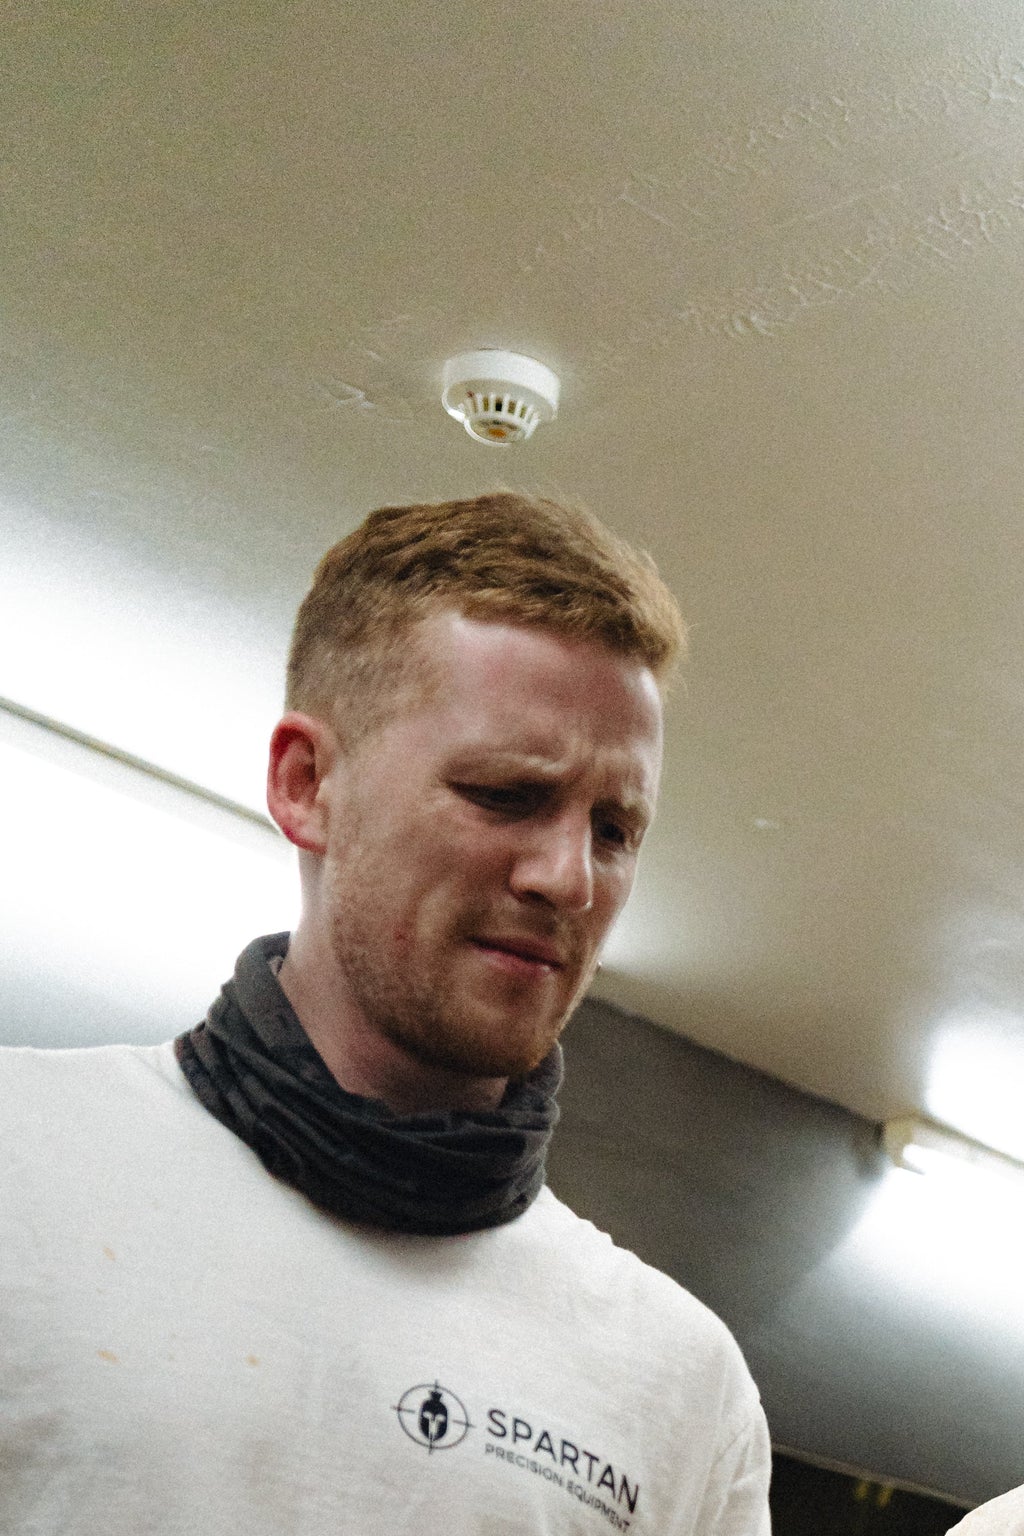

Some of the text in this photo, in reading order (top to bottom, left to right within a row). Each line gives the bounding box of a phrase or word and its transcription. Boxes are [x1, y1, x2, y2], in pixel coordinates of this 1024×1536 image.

[484, 1443, 631, 1533] PRECISION EQUIPMENT
[487, 1408, 639, 1514] SPARTAN
